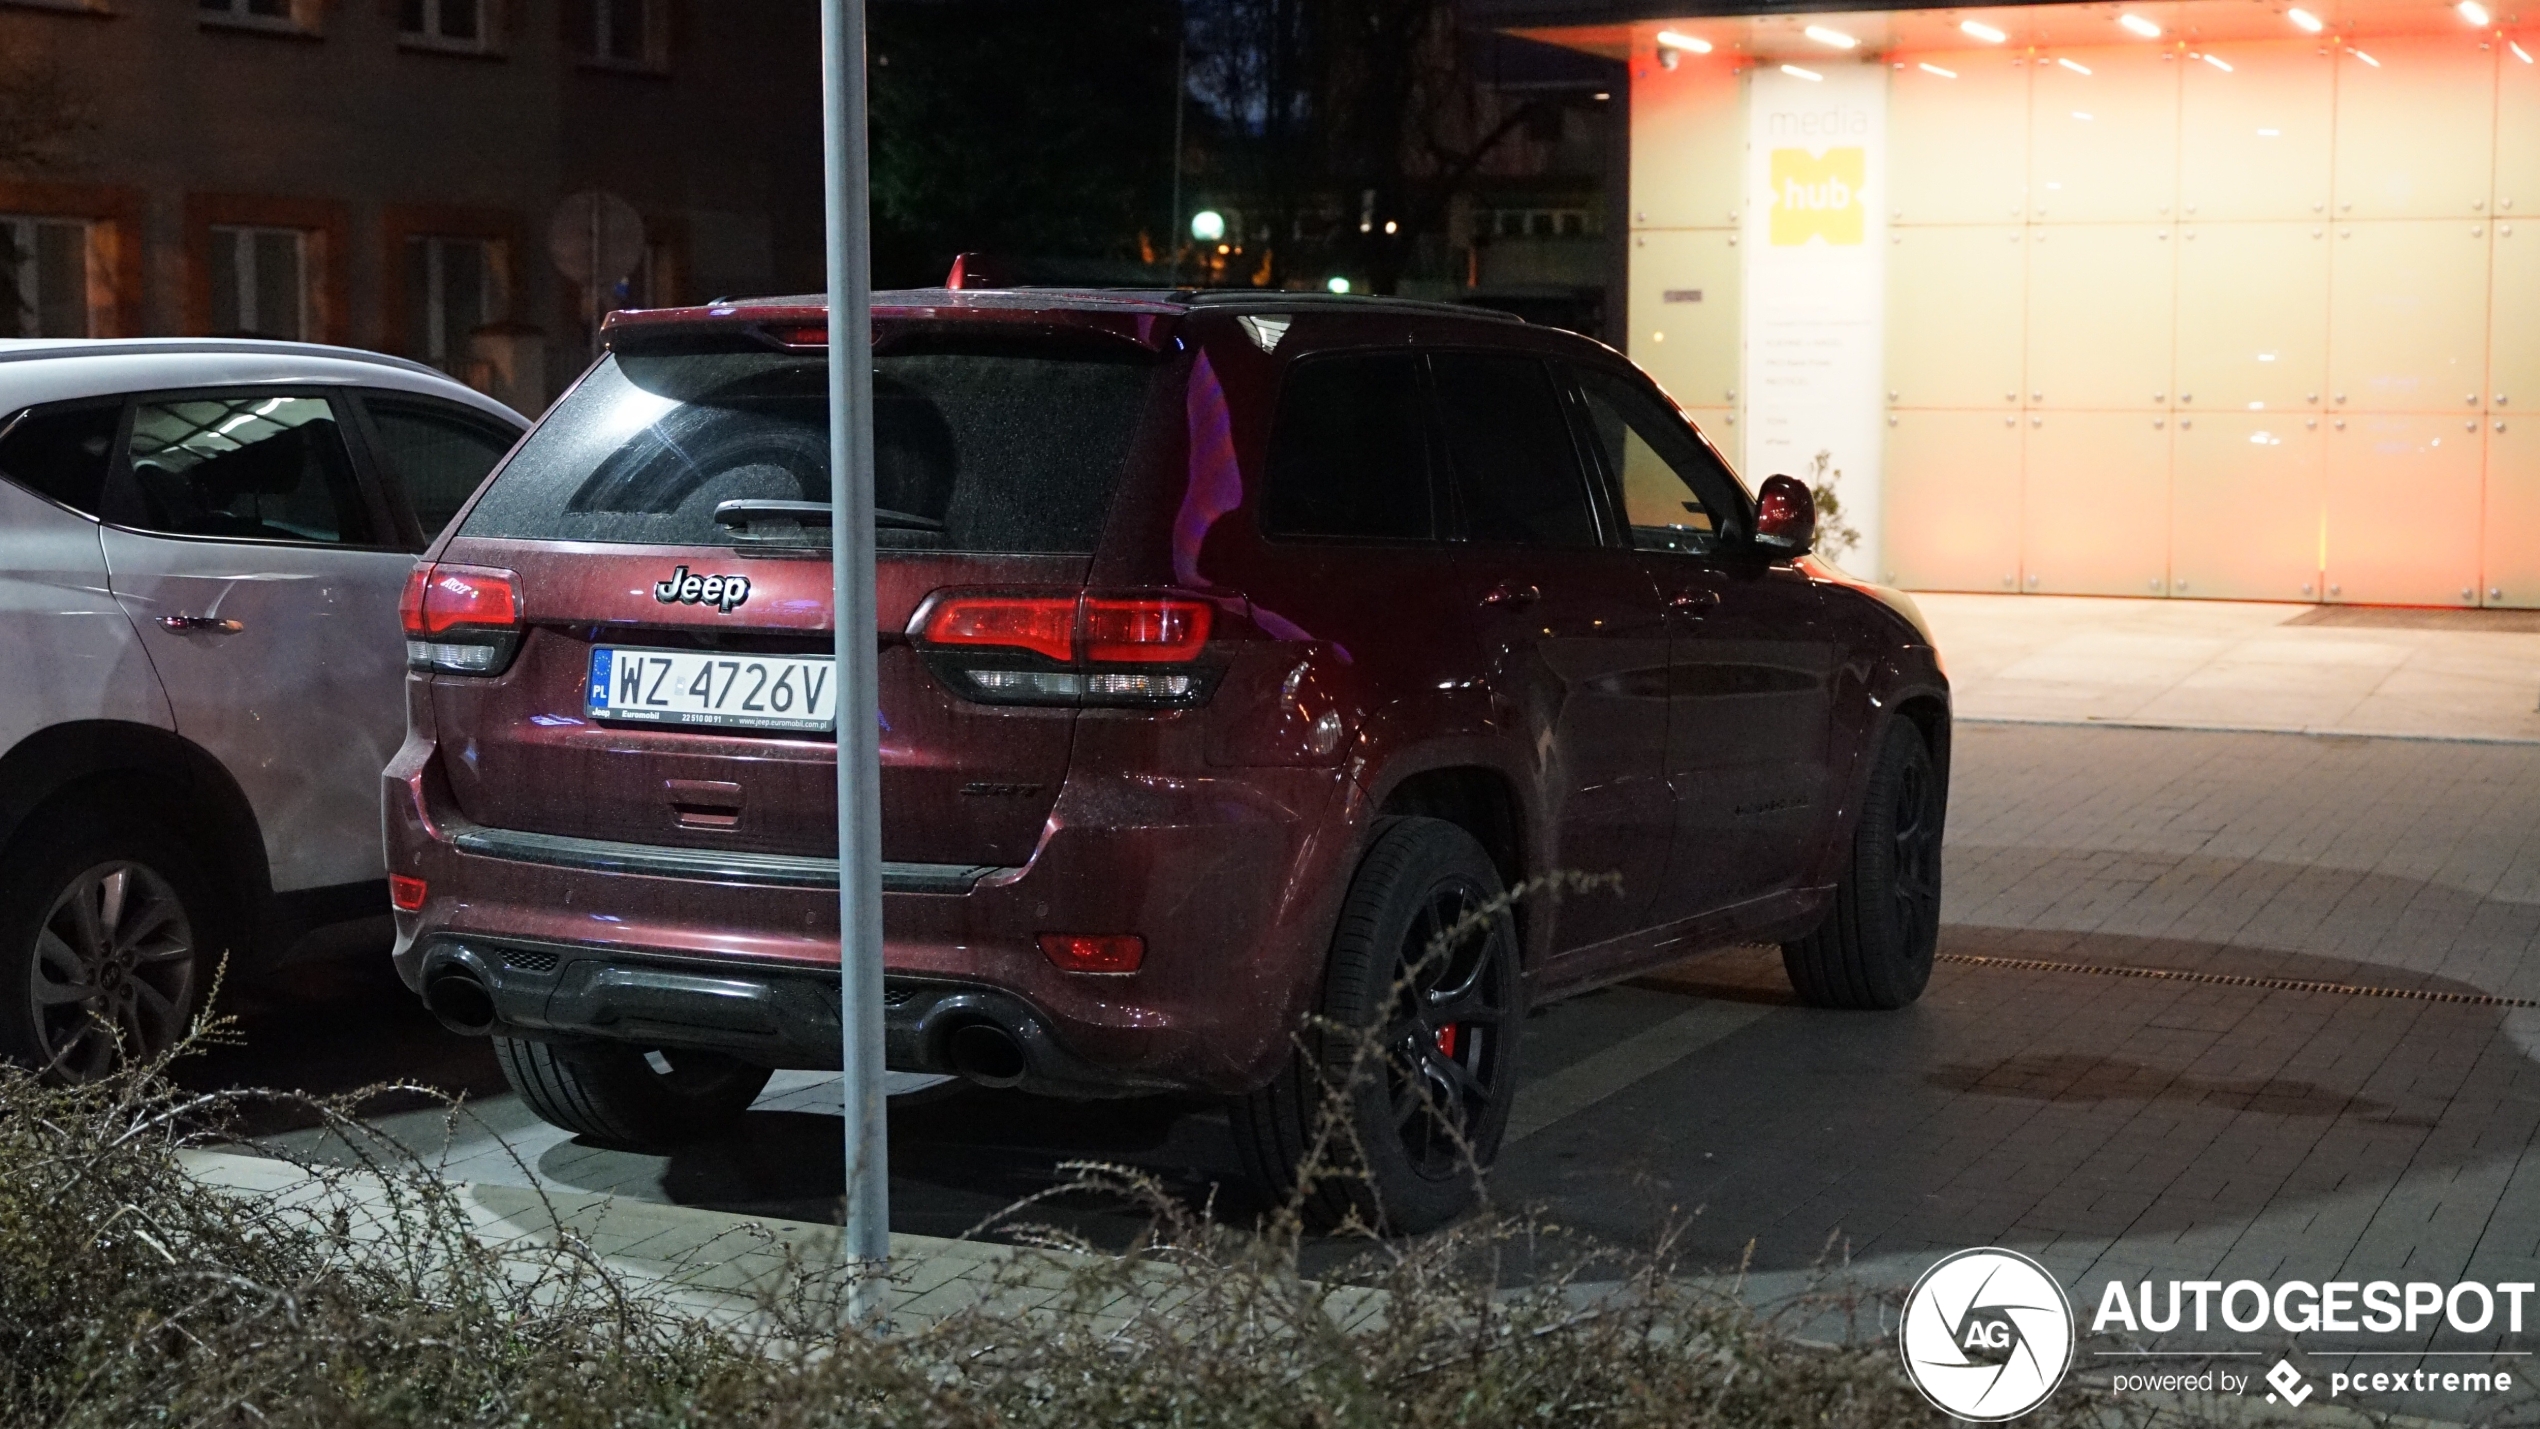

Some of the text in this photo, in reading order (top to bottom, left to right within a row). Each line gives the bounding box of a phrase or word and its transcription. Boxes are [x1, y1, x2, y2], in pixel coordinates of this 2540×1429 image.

[1770, 104, 1868, 136] media
[1784, 175, 1850, 210] hub
[654, 565, 752, 614] Jeep
[592, 684, 607, 699] PL
[620, 656, 828, 714] WZ 4726V
[592, 707, 611, 719] Jeep
[621, 710, 660, 720] Euromobil
[738, 717, 827, 730] www.jeep.euromobil.com.pl
